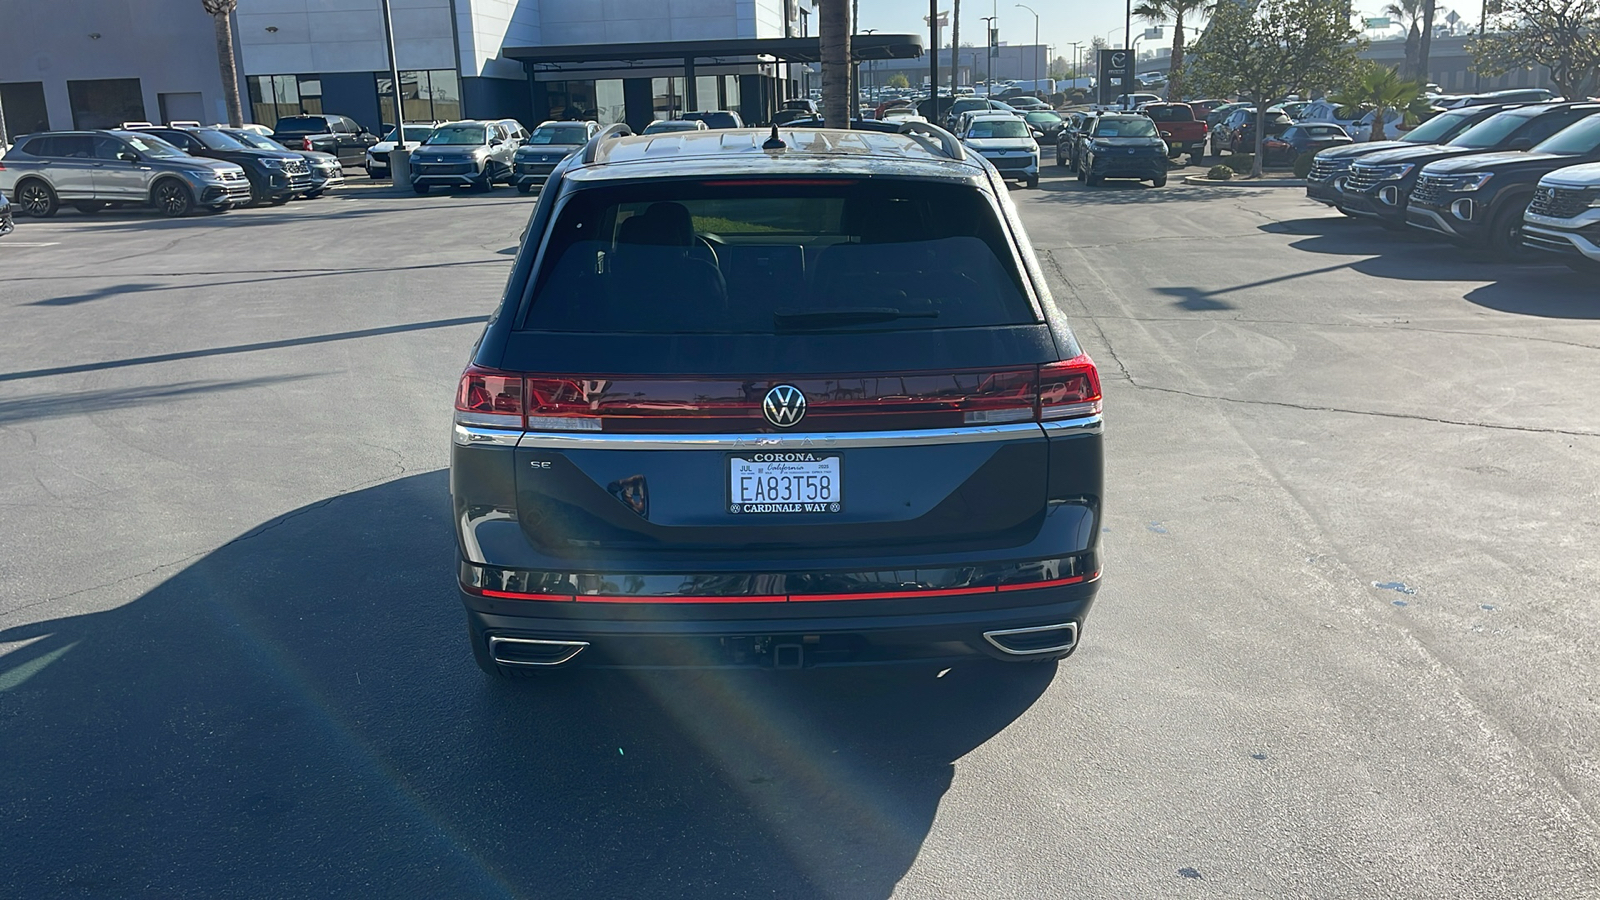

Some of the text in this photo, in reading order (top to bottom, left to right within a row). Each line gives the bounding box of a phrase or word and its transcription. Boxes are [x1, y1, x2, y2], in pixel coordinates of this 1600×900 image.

[754, 453, 814, 462] CORONA
[530, 461, 551, 469] SE
[767, 463, 804, 474] California
[741, 476, 831, 501] EA83T58
[743, 504, 827, 513] CARDINALE WAY
